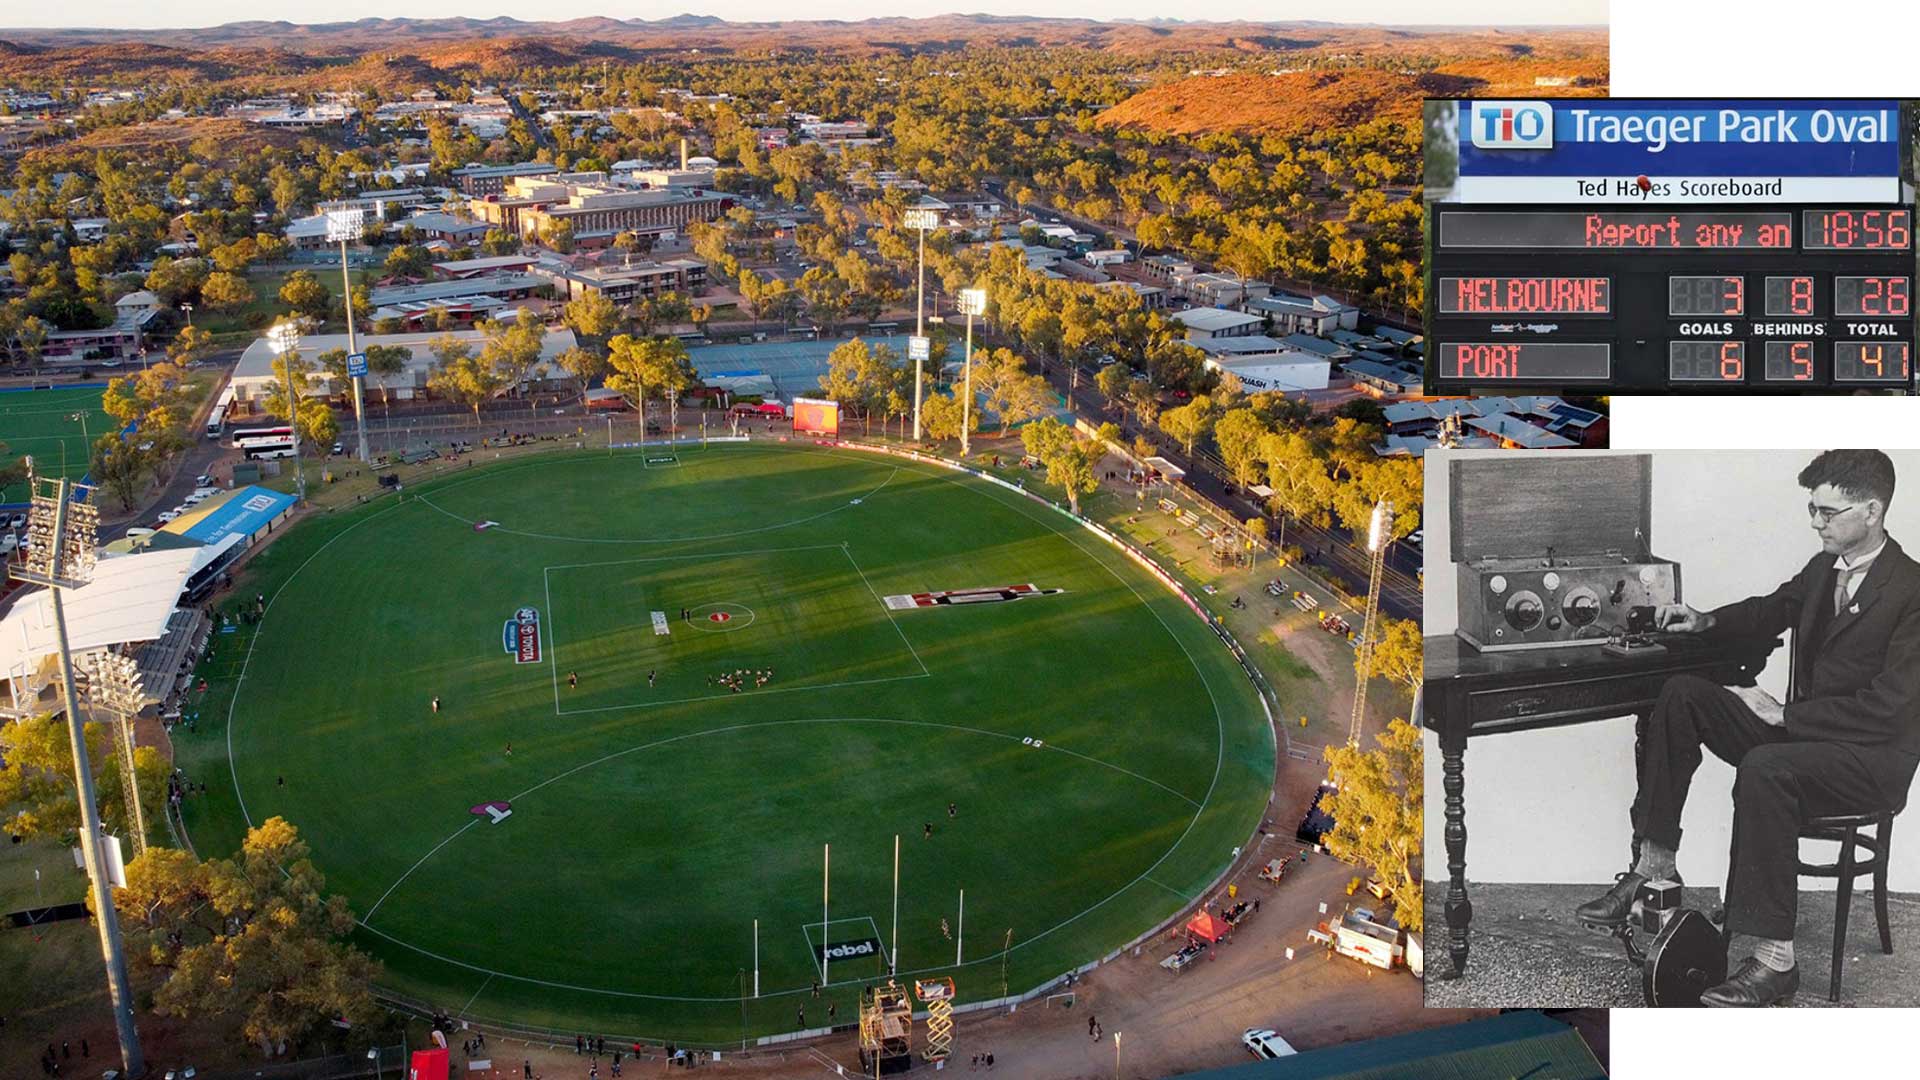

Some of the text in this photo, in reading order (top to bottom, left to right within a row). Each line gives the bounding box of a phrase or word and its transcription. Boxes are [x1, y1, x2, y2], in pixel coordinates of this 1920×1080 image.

[1571, 109, 1888, 152] Traeger Park Oval
[1577, 178, 1782, 200] Ted Hayes Scoreboard
[1586, 214, 1791, 248] Report any an
[1823, 211, 1908, 247] 18:56
[1458, 279, 1607, 312] MELBOURNE
[1723, 278, 1742, 314] 3
[1791, 278, 1812, 314] 8
[1862, 278, 1908, 314] 26
[1679, 323, 1733, 336] GOALS
[1754, 323, 1824, 336] BEHINDS
[1847, 323, 1898, 336] TOTAL
[1457, 344, 1521, 378] PORT
[1721, 343, 1741, 380] 6
[1791, 343, 1812, 380] 5
[1861, 344, 1908, 378] 41
[1238, 376, 1268, 389] QUASH
[522, 635, 534, 661] TOYOTA
[825, 941, 874, 959] rebel
